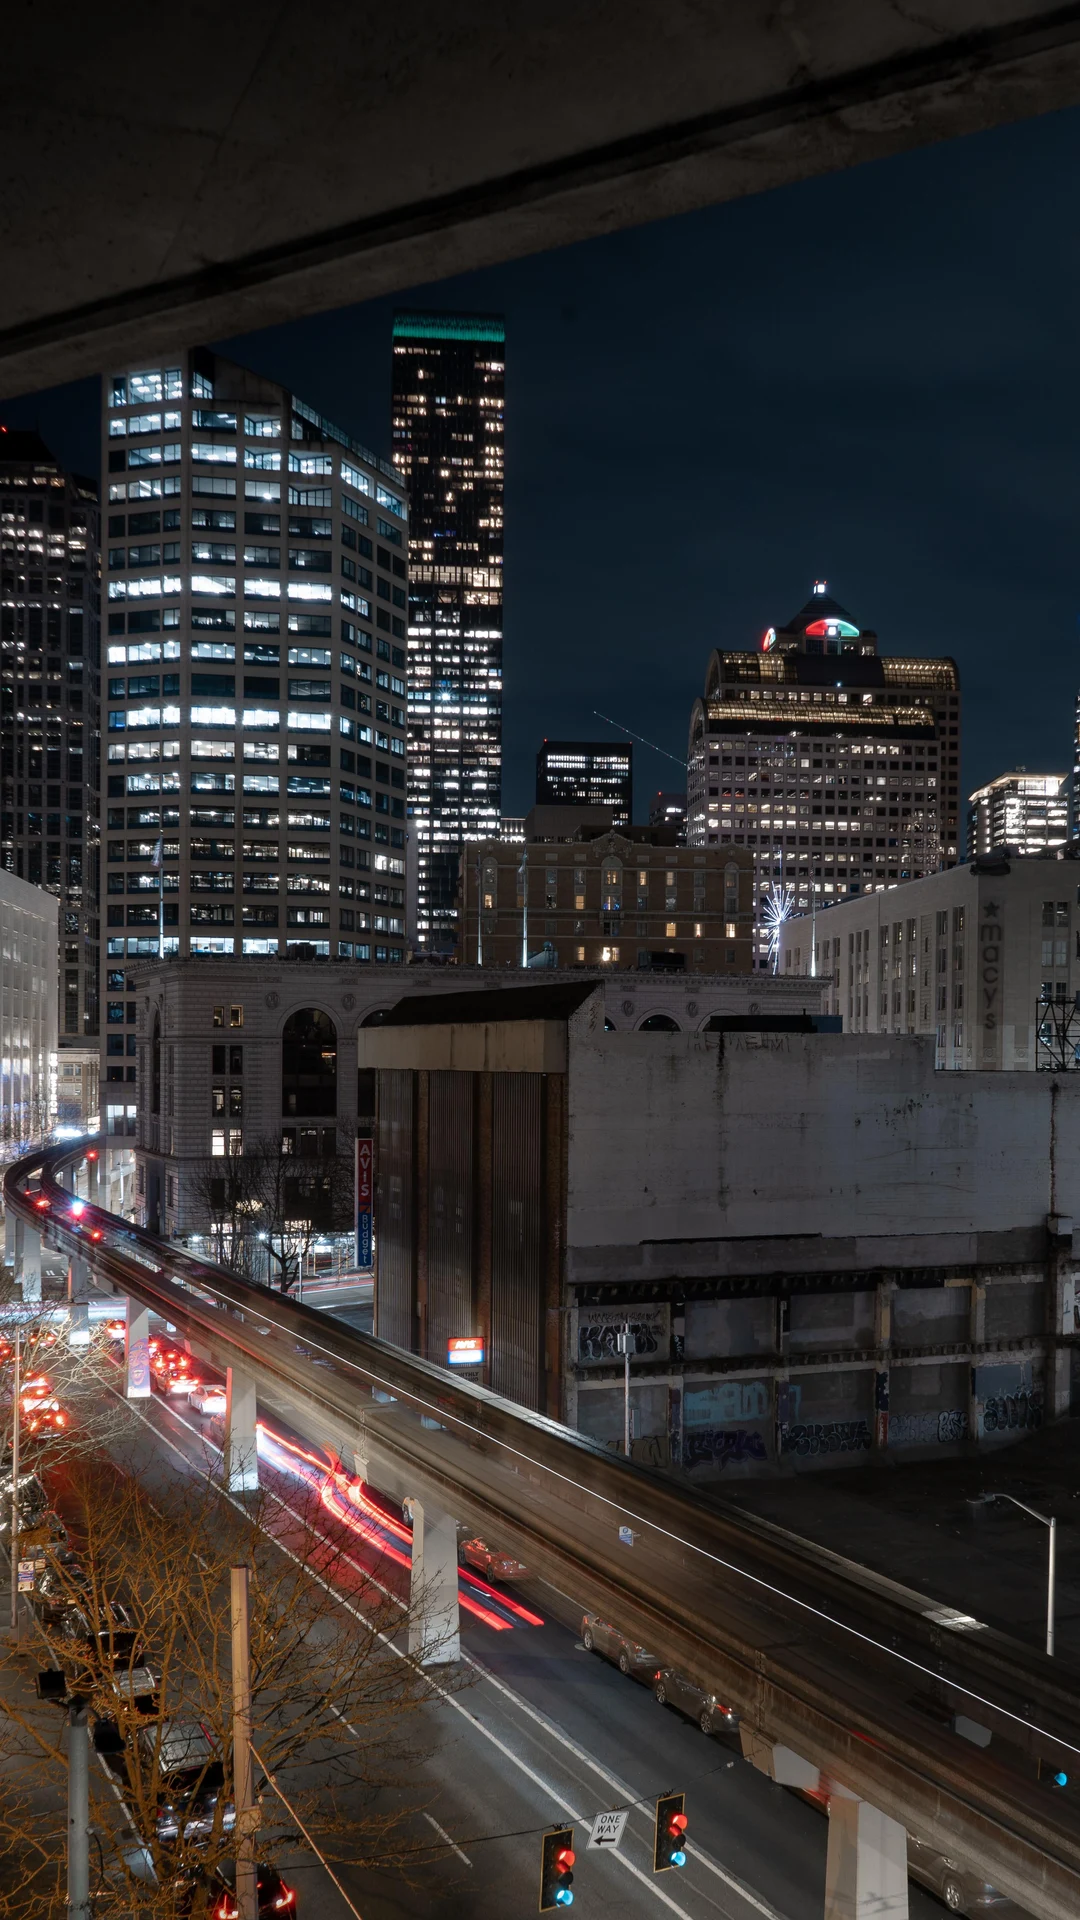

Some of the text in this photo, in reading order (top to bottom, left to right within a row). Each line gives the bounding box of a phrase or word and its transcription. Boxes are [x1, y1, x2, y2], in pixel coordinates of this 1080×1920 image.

[980, 924, 1002, 1030] macys
[359, 1144, 371, 1196] AVIS
[361, 1214, 369, 1264] Budget
[596, 1825, 620, 1834] WAY
[600, 1815, 621, 1824] ONE
